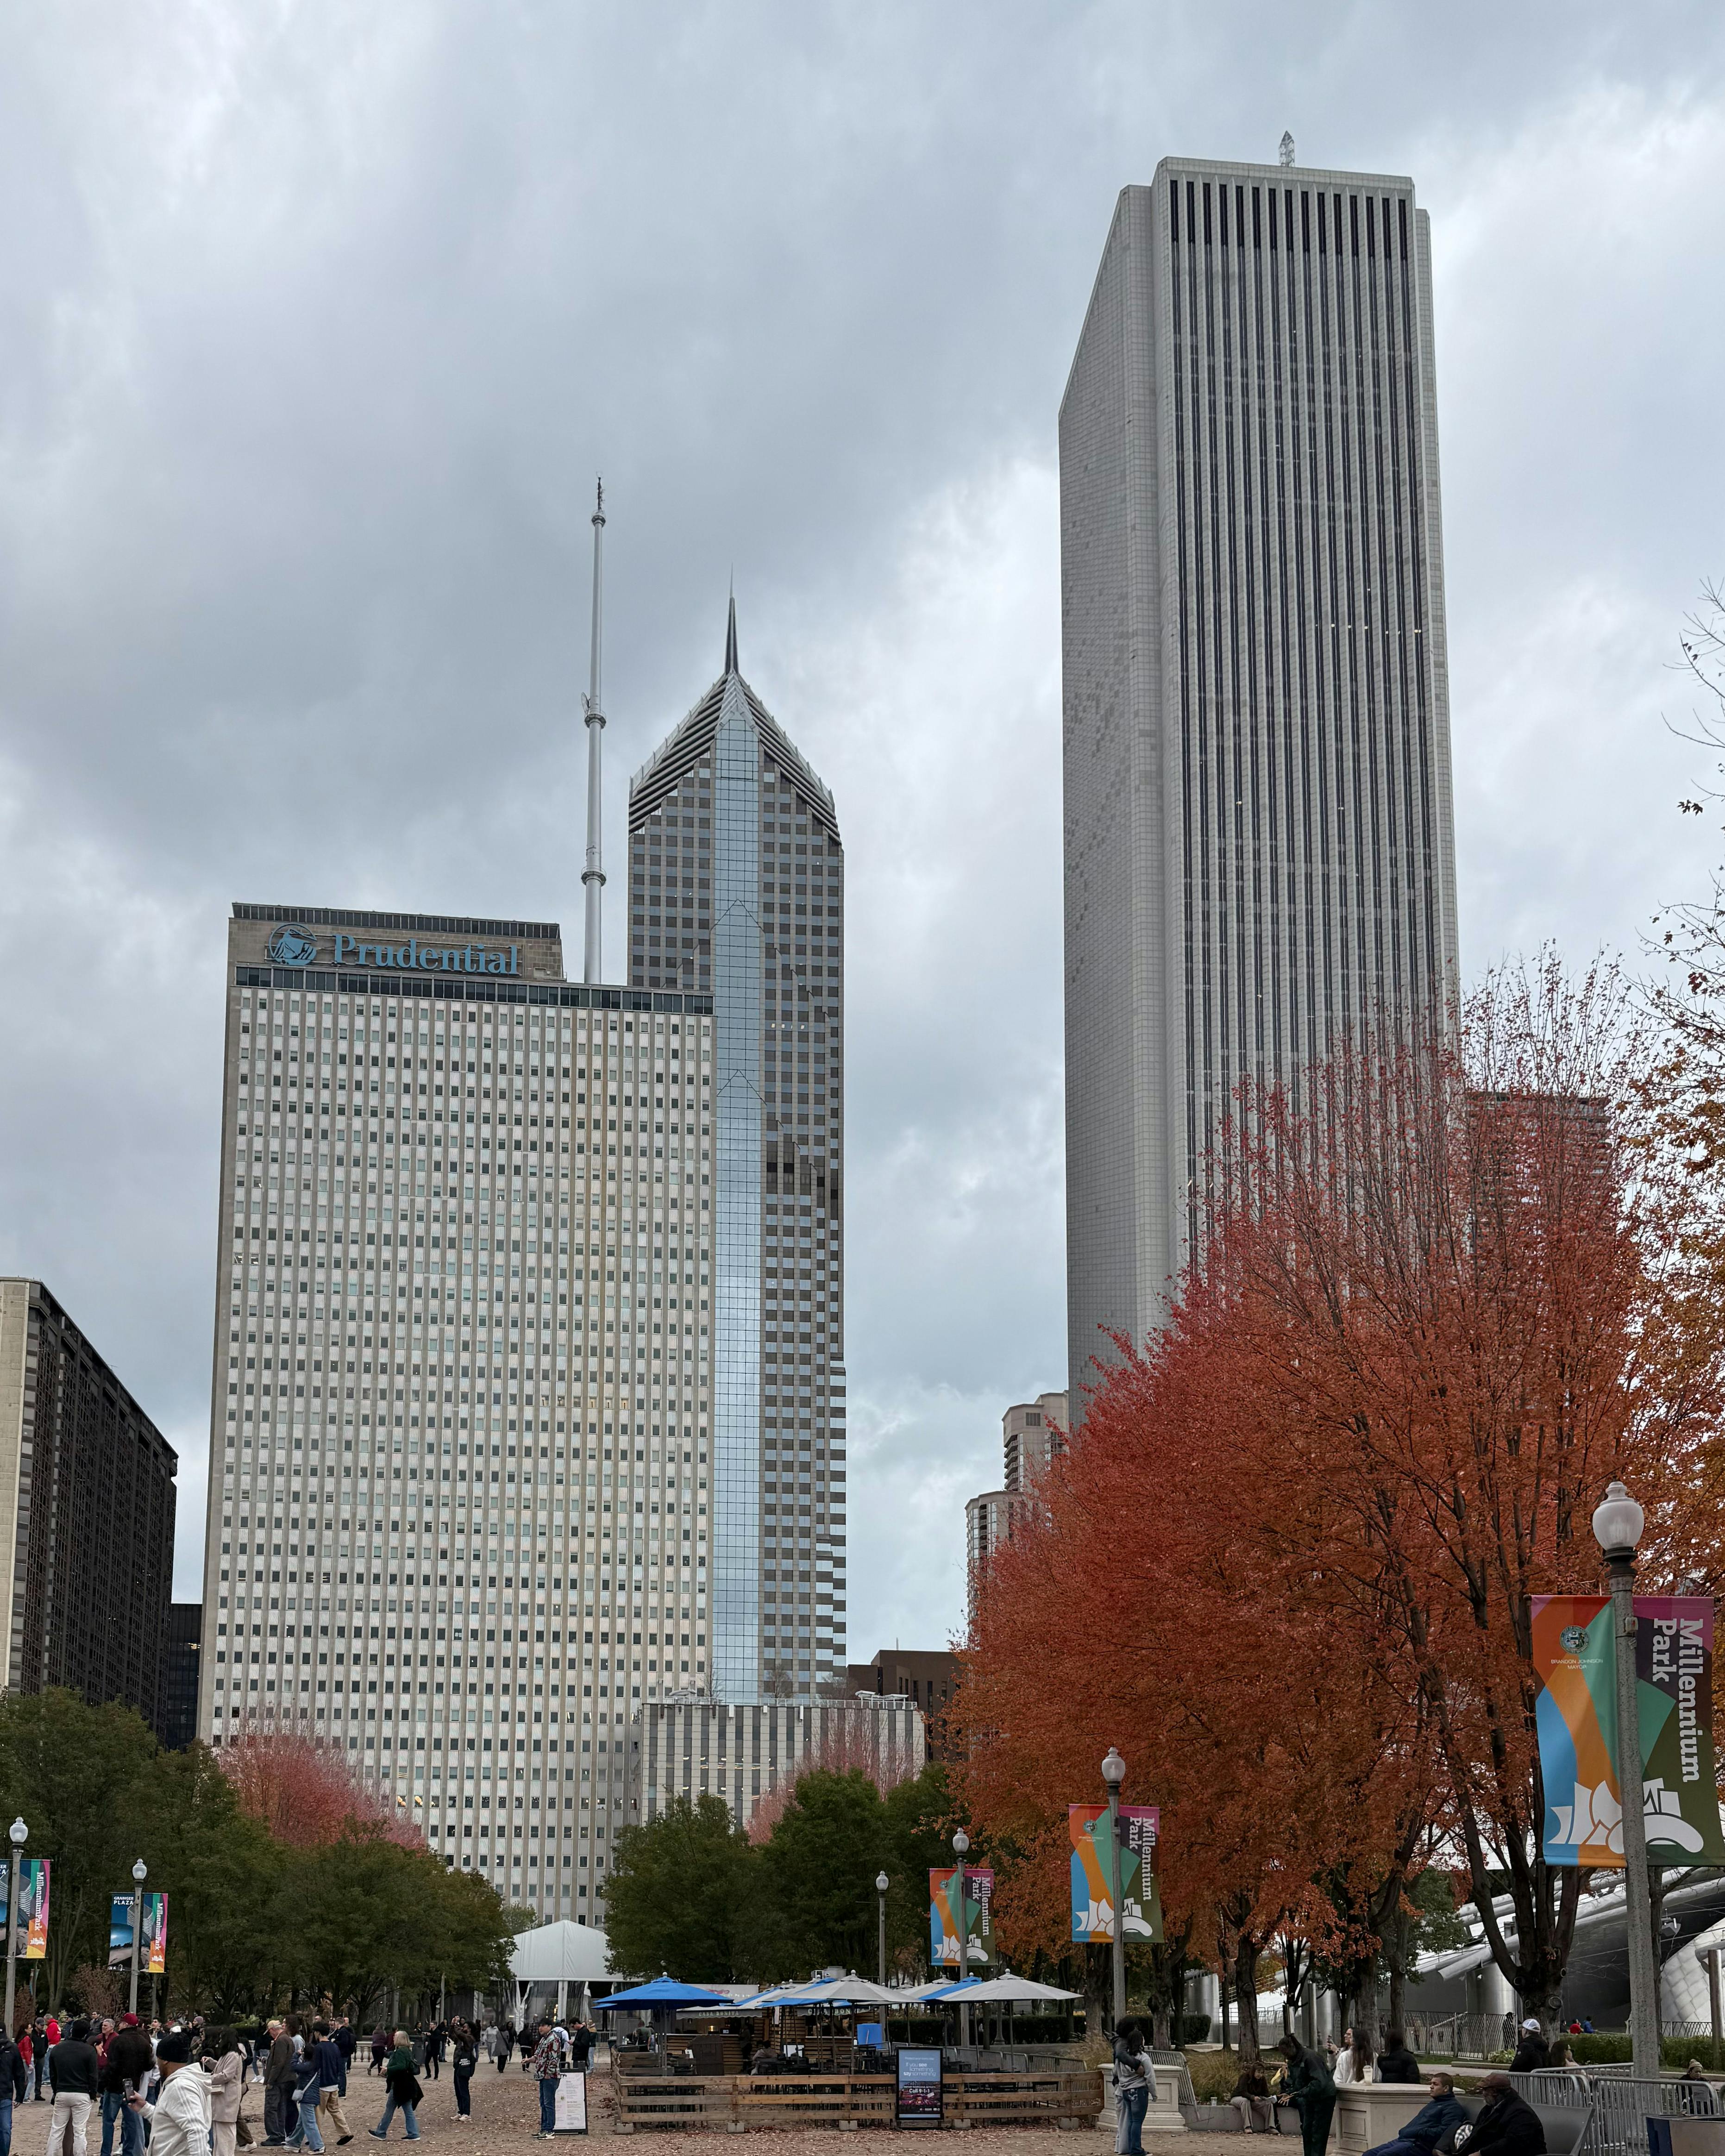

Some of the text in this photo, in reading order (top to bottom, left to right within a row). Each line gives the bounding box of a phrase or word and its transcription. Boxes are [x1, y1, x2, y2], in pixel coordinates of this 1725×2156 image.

[333, 934, 519, 975] Prudential
[1652, 1618, 1677, 1682] Park
[1679, 1618, 1703, 1782] Millennium
[1129, 1817, 1142, 1850] Park
[1142, 1818, 1155, 1900] Millennium
[972, 1877, 981, 1900] Park
[982, 1877, 991, 1936] Millennium
